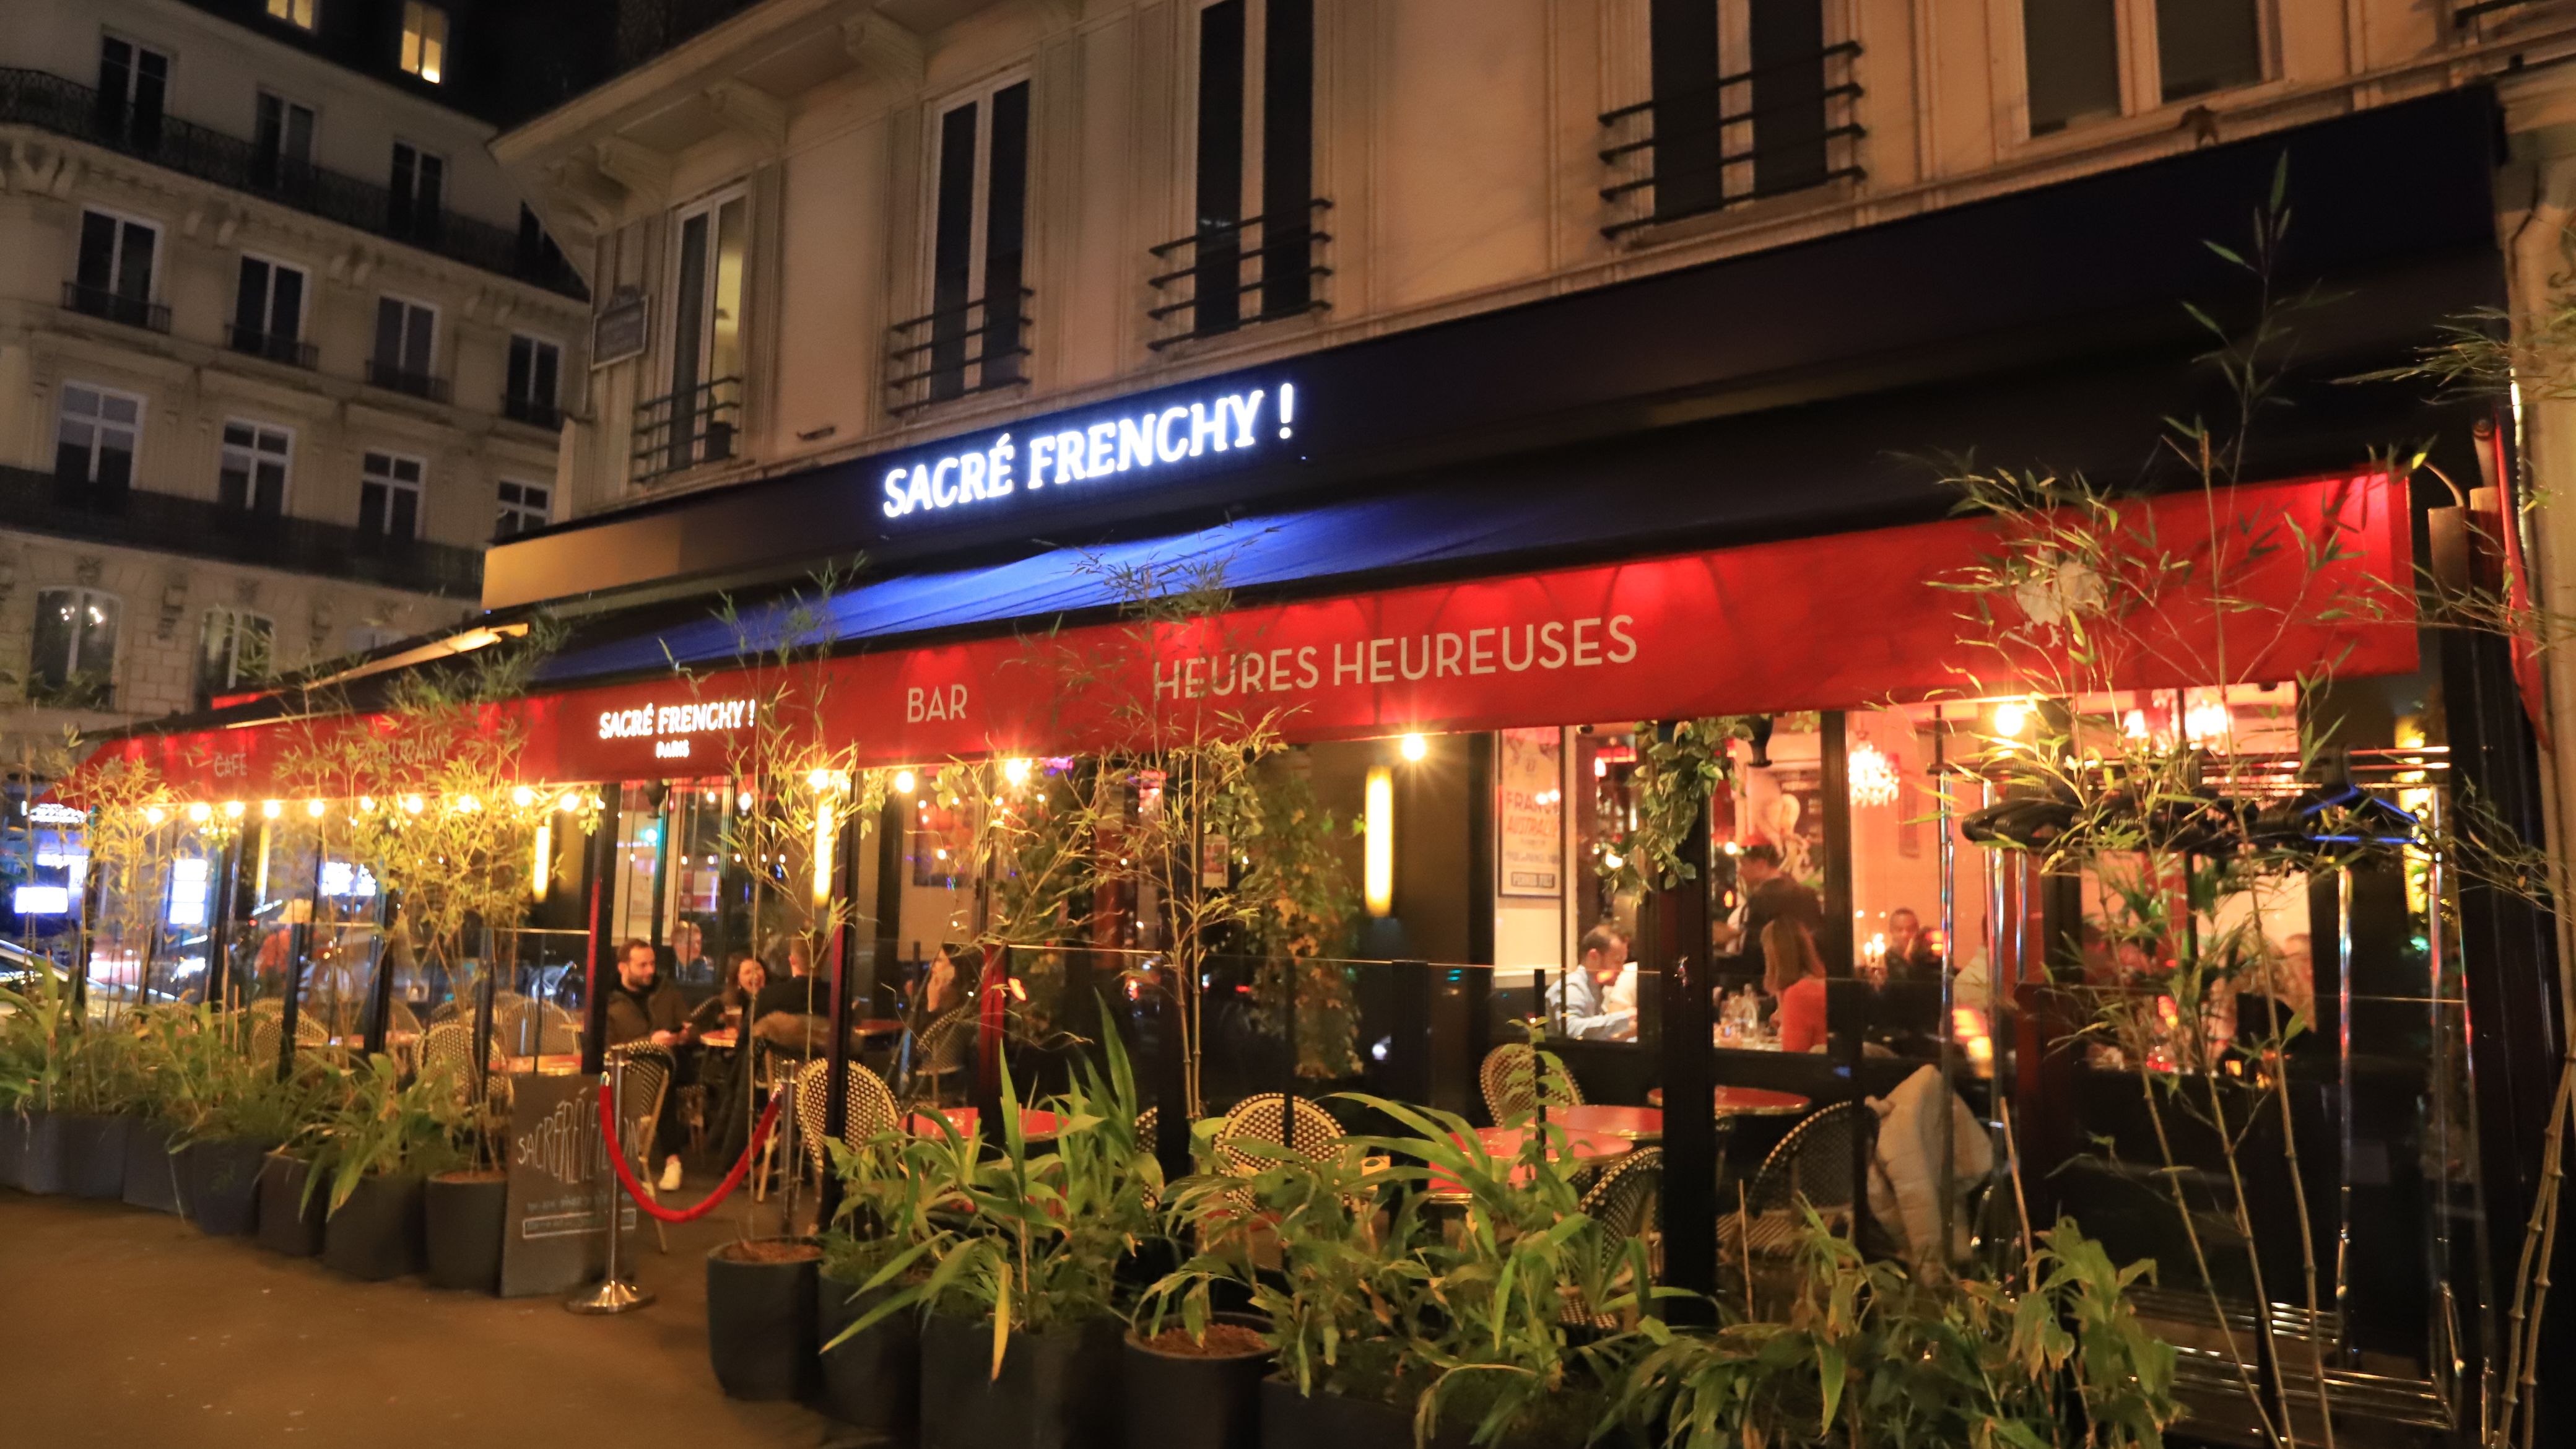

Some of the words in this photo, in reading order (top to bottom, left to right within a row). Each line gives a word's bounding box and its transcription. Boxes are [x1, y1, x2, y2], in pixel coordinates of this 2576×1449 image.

[883, 433, 1014, 518] SACRÉ
[1027, 389, 1264, 489] FRENCHY
[1279, 383, 1293, 439] !
[1154, 646, 1319, 700] HEURES
[1333, 615, 1637, 686] HEUREUSES
[599, 703, 655, 739] SACRÉ
[657, 700, 746, 735] FRENCHY
[748, 699, 756, 727] !
[907, 684, 967, 723] BAR
[348, 732, 448, 769] ETAURANT
[655, 739, 690, 759] PARIS
[1506, 791, 1560, 815] FRAN
